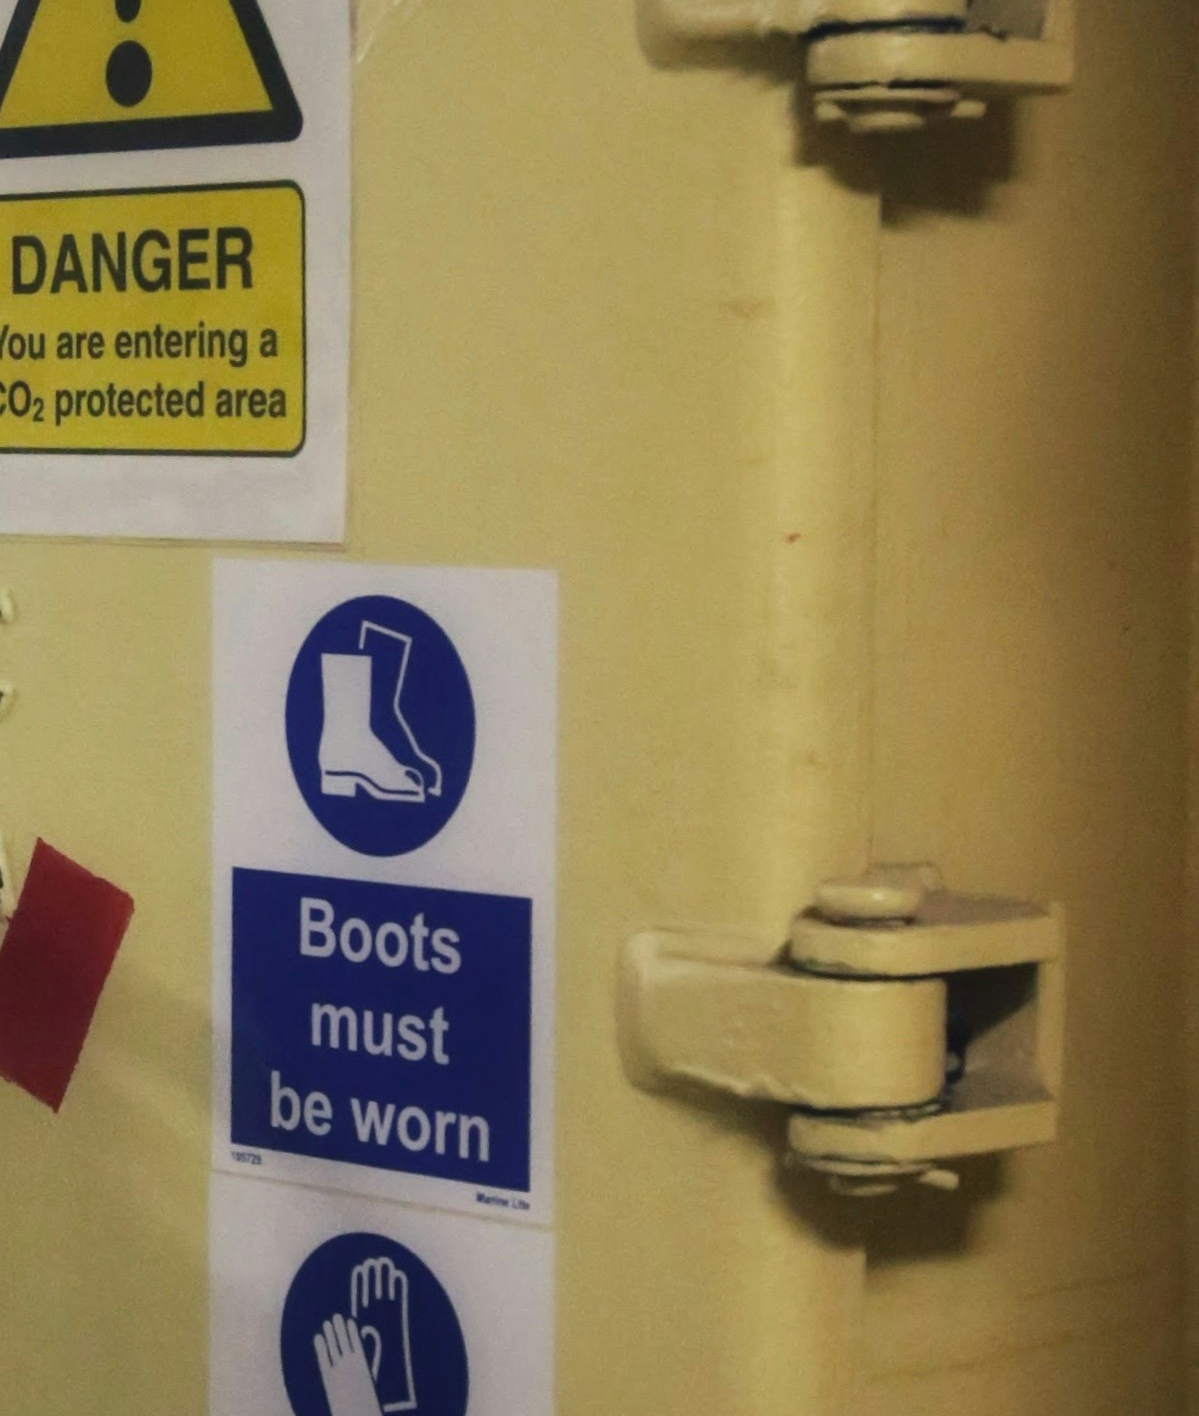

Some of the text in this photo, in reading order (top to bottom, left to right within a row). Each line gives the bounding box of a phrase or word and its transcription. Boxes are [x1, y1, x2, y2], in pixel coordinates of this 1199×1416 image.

[11, 226, 254, 295] DANGER
[56, 329, 105, 360] are
[114, 320, 249, 368] entering
[259, 327, 278, 358] a
[54, 380, 206, 427] protected
[215, 388, 287, 418] area
[300, 896, 462, 975] Boots
[311, 1002, 450, 1066] must
[270, 1070, 490, 1163] be worn
